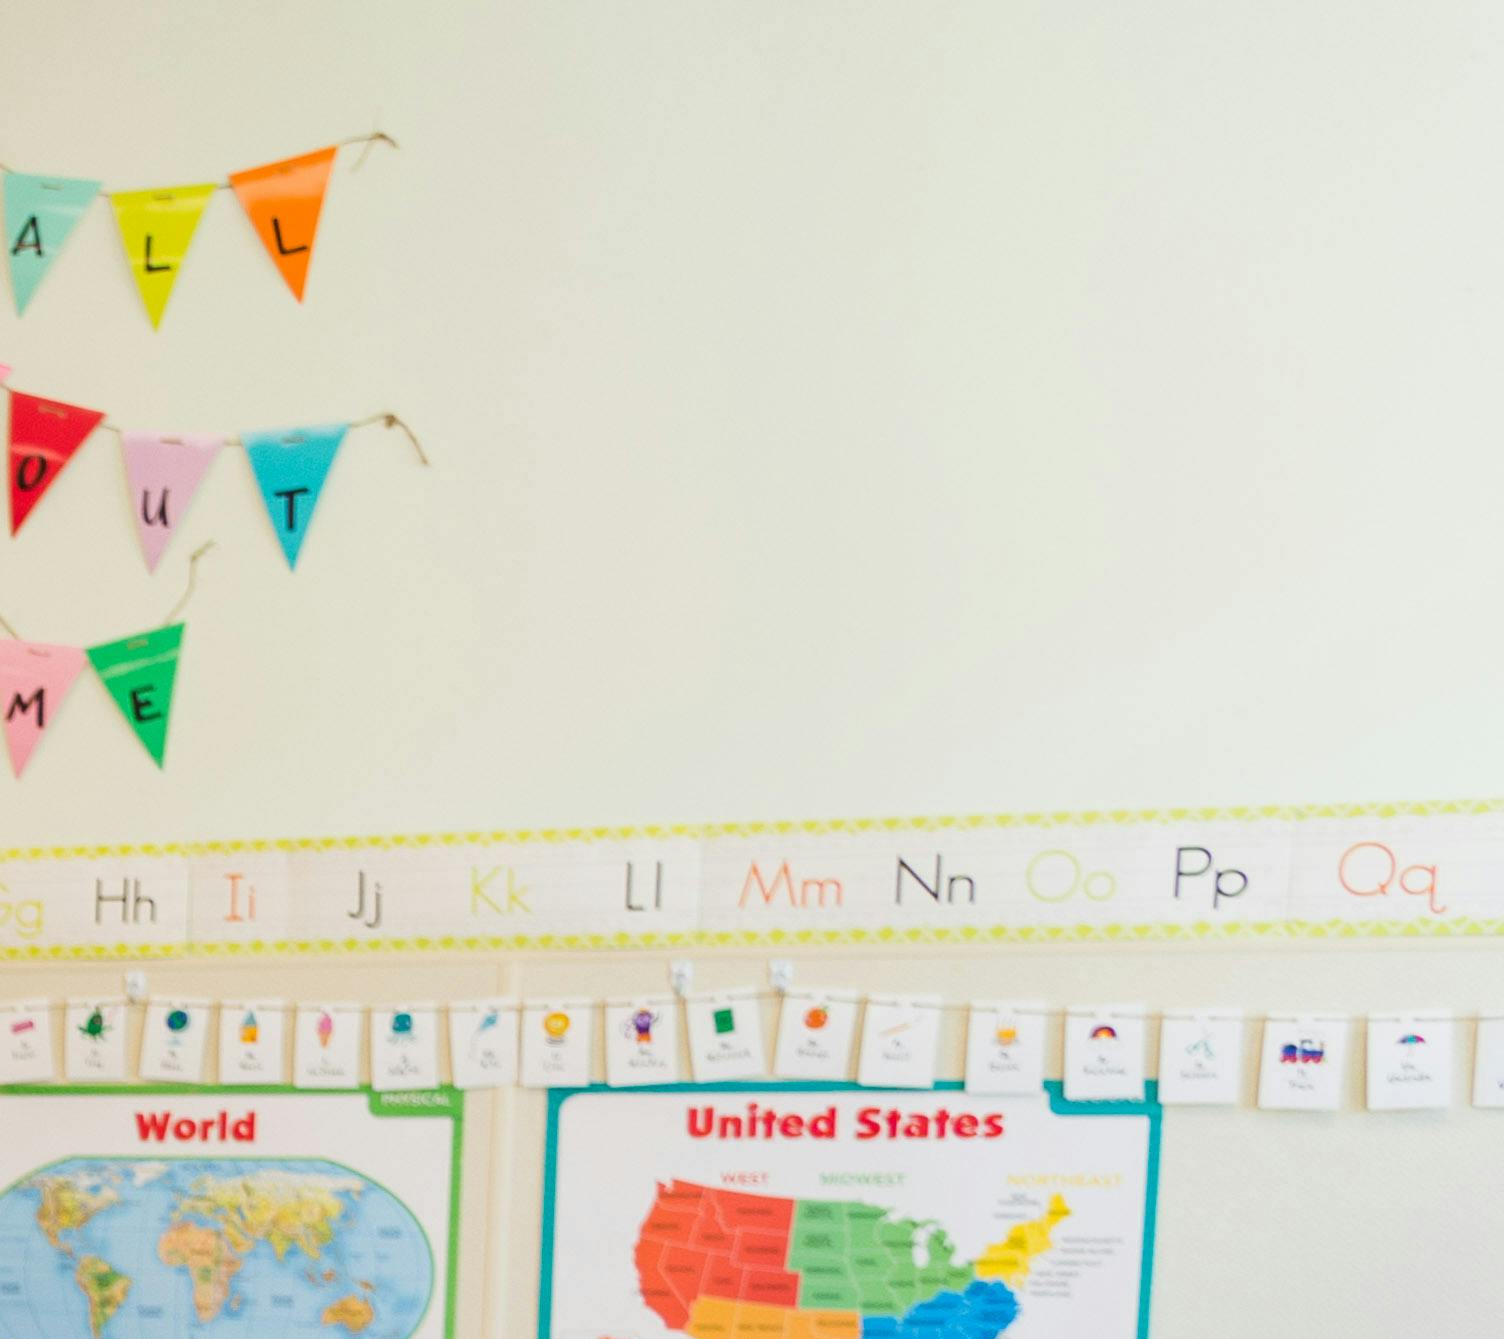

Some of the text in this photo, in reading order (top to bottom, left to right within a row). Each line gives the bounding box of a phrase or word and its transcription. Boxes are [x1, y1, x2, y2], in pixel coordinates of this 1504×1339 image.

[11, 214, 308, 272] ALL
[4, 684, 161, 729] ME
[94, 877, 157, 926] Hh
[222, 873, 258, 924] Ii
[348, 869, 385, 931] Jj
[469, 864, 532, 916] Kk
[624, 860, 664, 913] Ll
[738, 859, 844, 909] Mm
[894, 853, 977, 907] Nn
[1025, 849, 1119, 905] Oo
[1172, 845, 1250, 910] Pp
[1337, 841, 1448, 914] Qq
[135, 1111, 258, 1143] World
[688, 1103, 1005, 1141] United States
[720, 1171, 1124, 1188] WEST MIDWEST NORTHEAST
